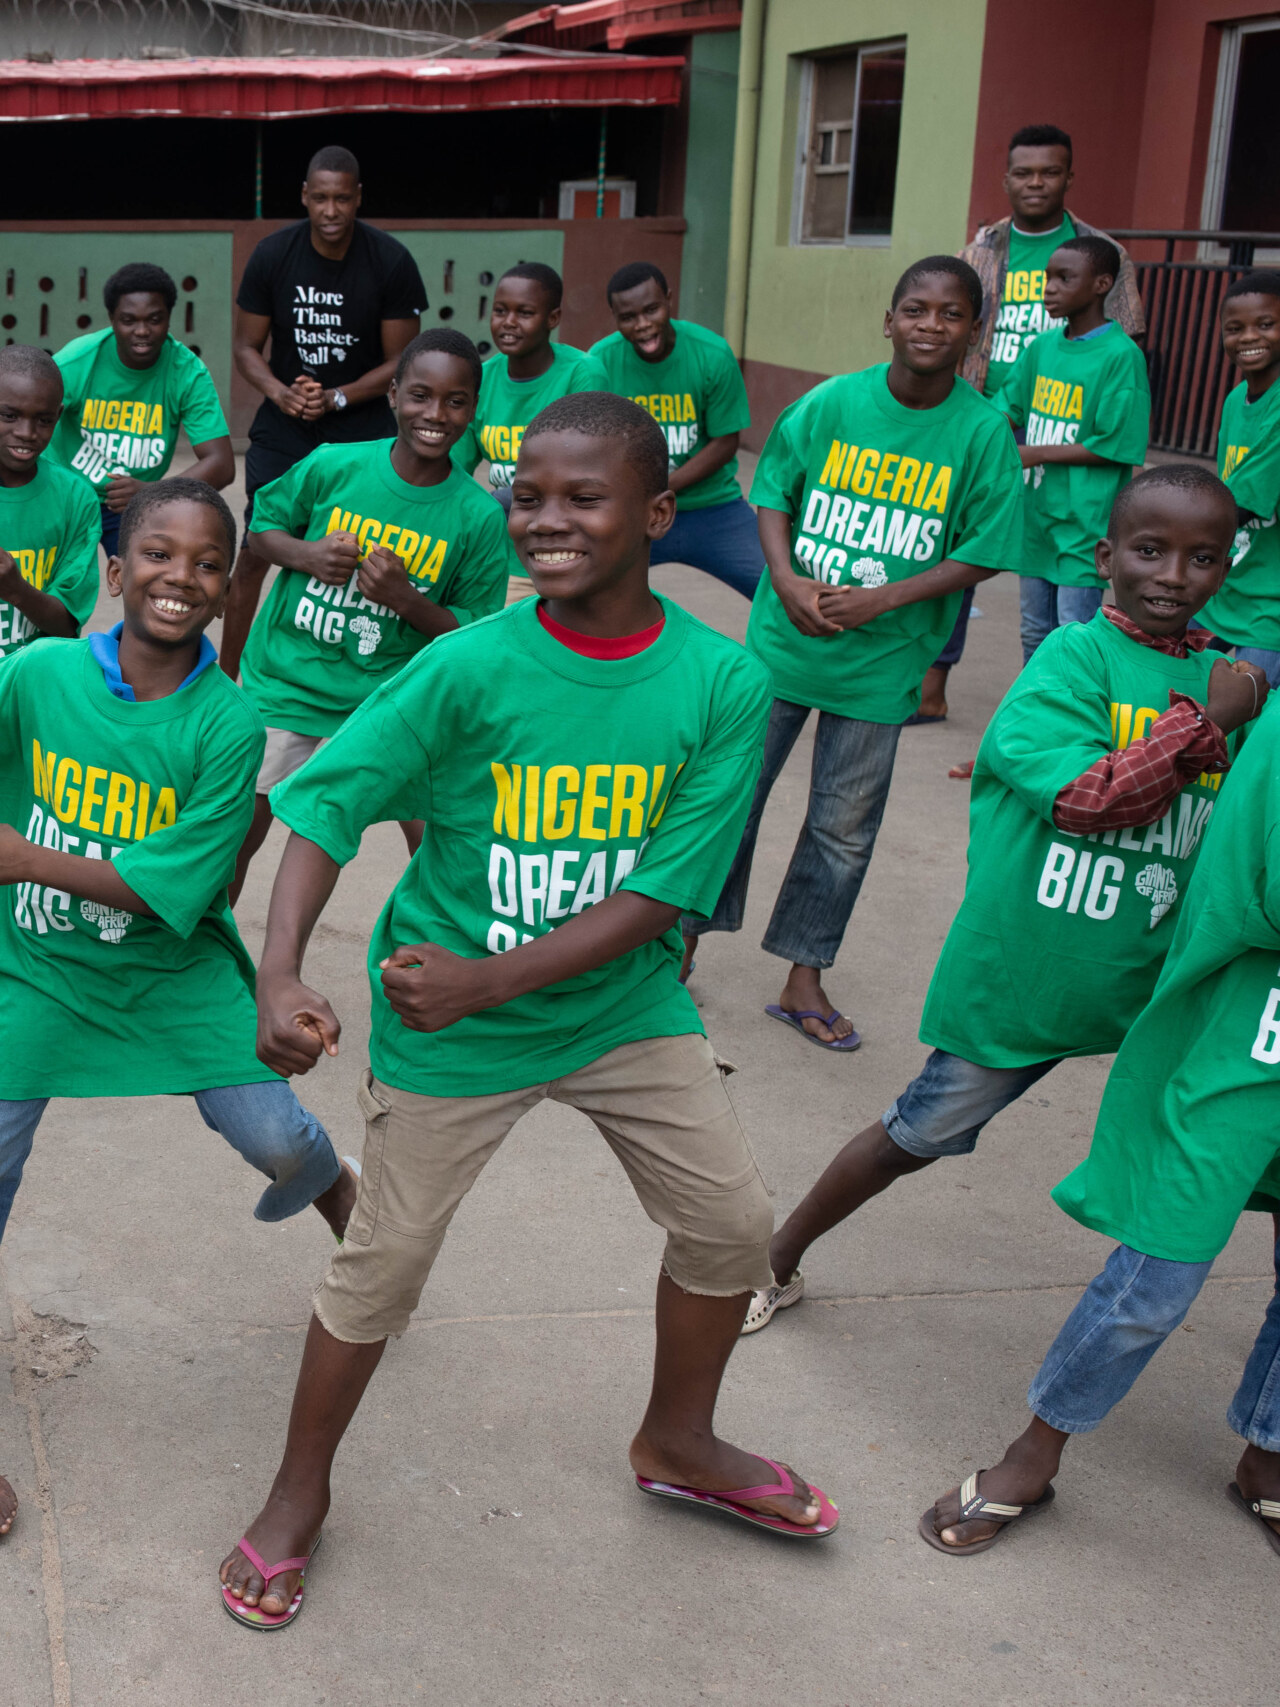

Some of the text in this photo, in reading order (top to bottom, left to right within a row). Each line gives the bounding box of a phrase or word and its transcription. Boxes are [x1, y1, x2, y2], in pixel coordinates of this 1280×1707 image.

[293, 285, 344, 306] More
[293, 307, 342, 327] Than
[294, 328, 360, 346] Basket-
[297, 346, 329, 365] Ball
[81, 398, 163, 435] NIGERIA
[819, 439, 952, 514] NIGERIA
[802, 489, 942, 561] DREAMS
[488, 836, 650, 926] DREA
[1037, 842, 1126, 921] BIG
[1135, 863, 1177, 891] GIANTS
[1136, 886, 1154, 897] OF
[1151, 888, 1178, 905] AFRIC
[82, 913, 133, 931] OF AFRICA
